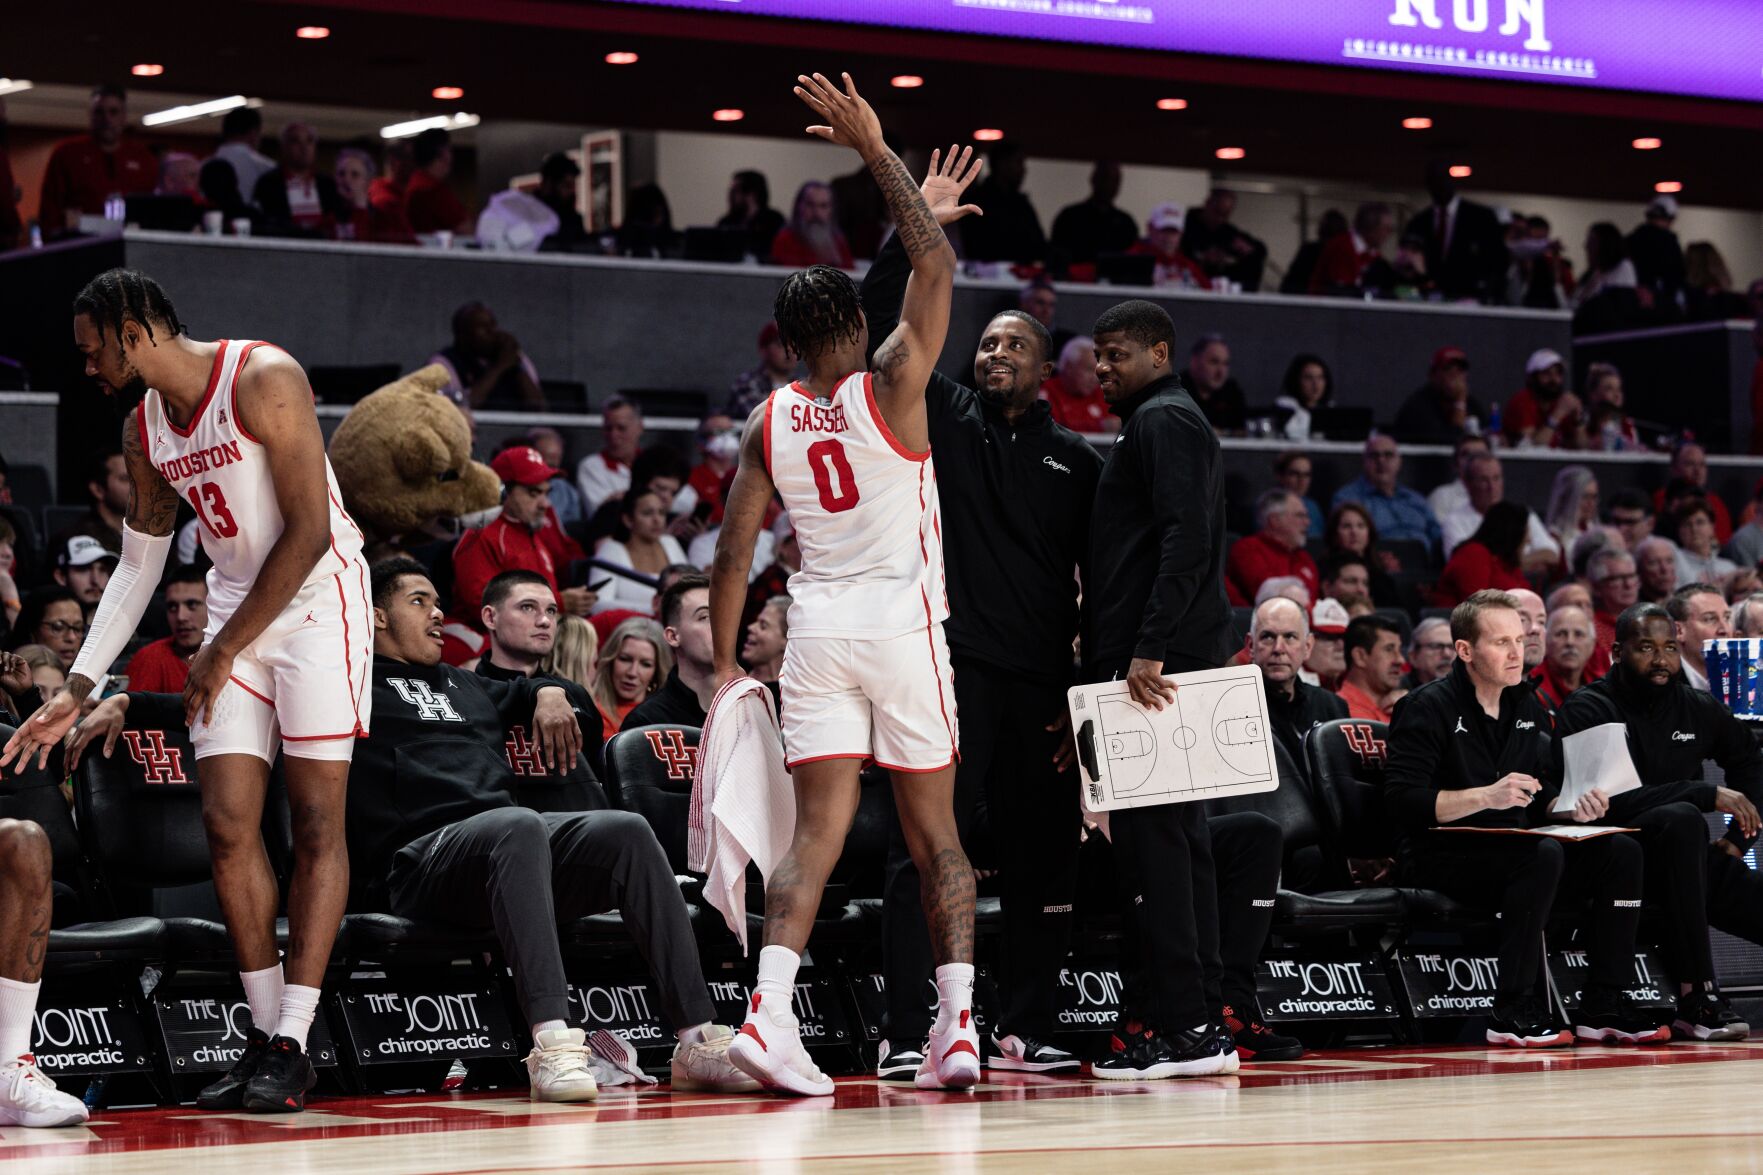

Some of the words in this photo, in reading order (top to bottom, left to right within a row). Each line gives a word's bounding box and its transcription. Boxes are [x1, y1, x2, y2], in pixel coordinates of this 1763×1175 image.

[790, 403, 849, 433] SASSER
[157, 439, 243, 483] HOUSTON
[807, 438, 861, 513] 0
[187, 481, 239, 539] 13
[386, 677, 463, 722] UH
[122, 730, 188, 784] UH
[1265, 960, 1299, 978] THE
[1298, 963, 1366, 996] JOINT
[1415, 954, 1445, 973] THE
[578, 985, 652, 1024] JOINT
[707, 982, 743, 1001] THE
[1073, 971, 1124, 1005] JOIN
[1278, 996, 1376, 1014] chiropractic
[1427, 994, 1495, 1011] chiroprac
[180, 999, 220, 1020] THE
[363, 992, 403, 1014] THE
[403, 993, 481, 1033] JOINT
[1058, 1008, 1119, 1025] chiropra
[34, 1007, 113, 1048] JOINT
[378, 1033, 491, 1054] chiropractic
[35, 1048, 124, 1070] ropractic
